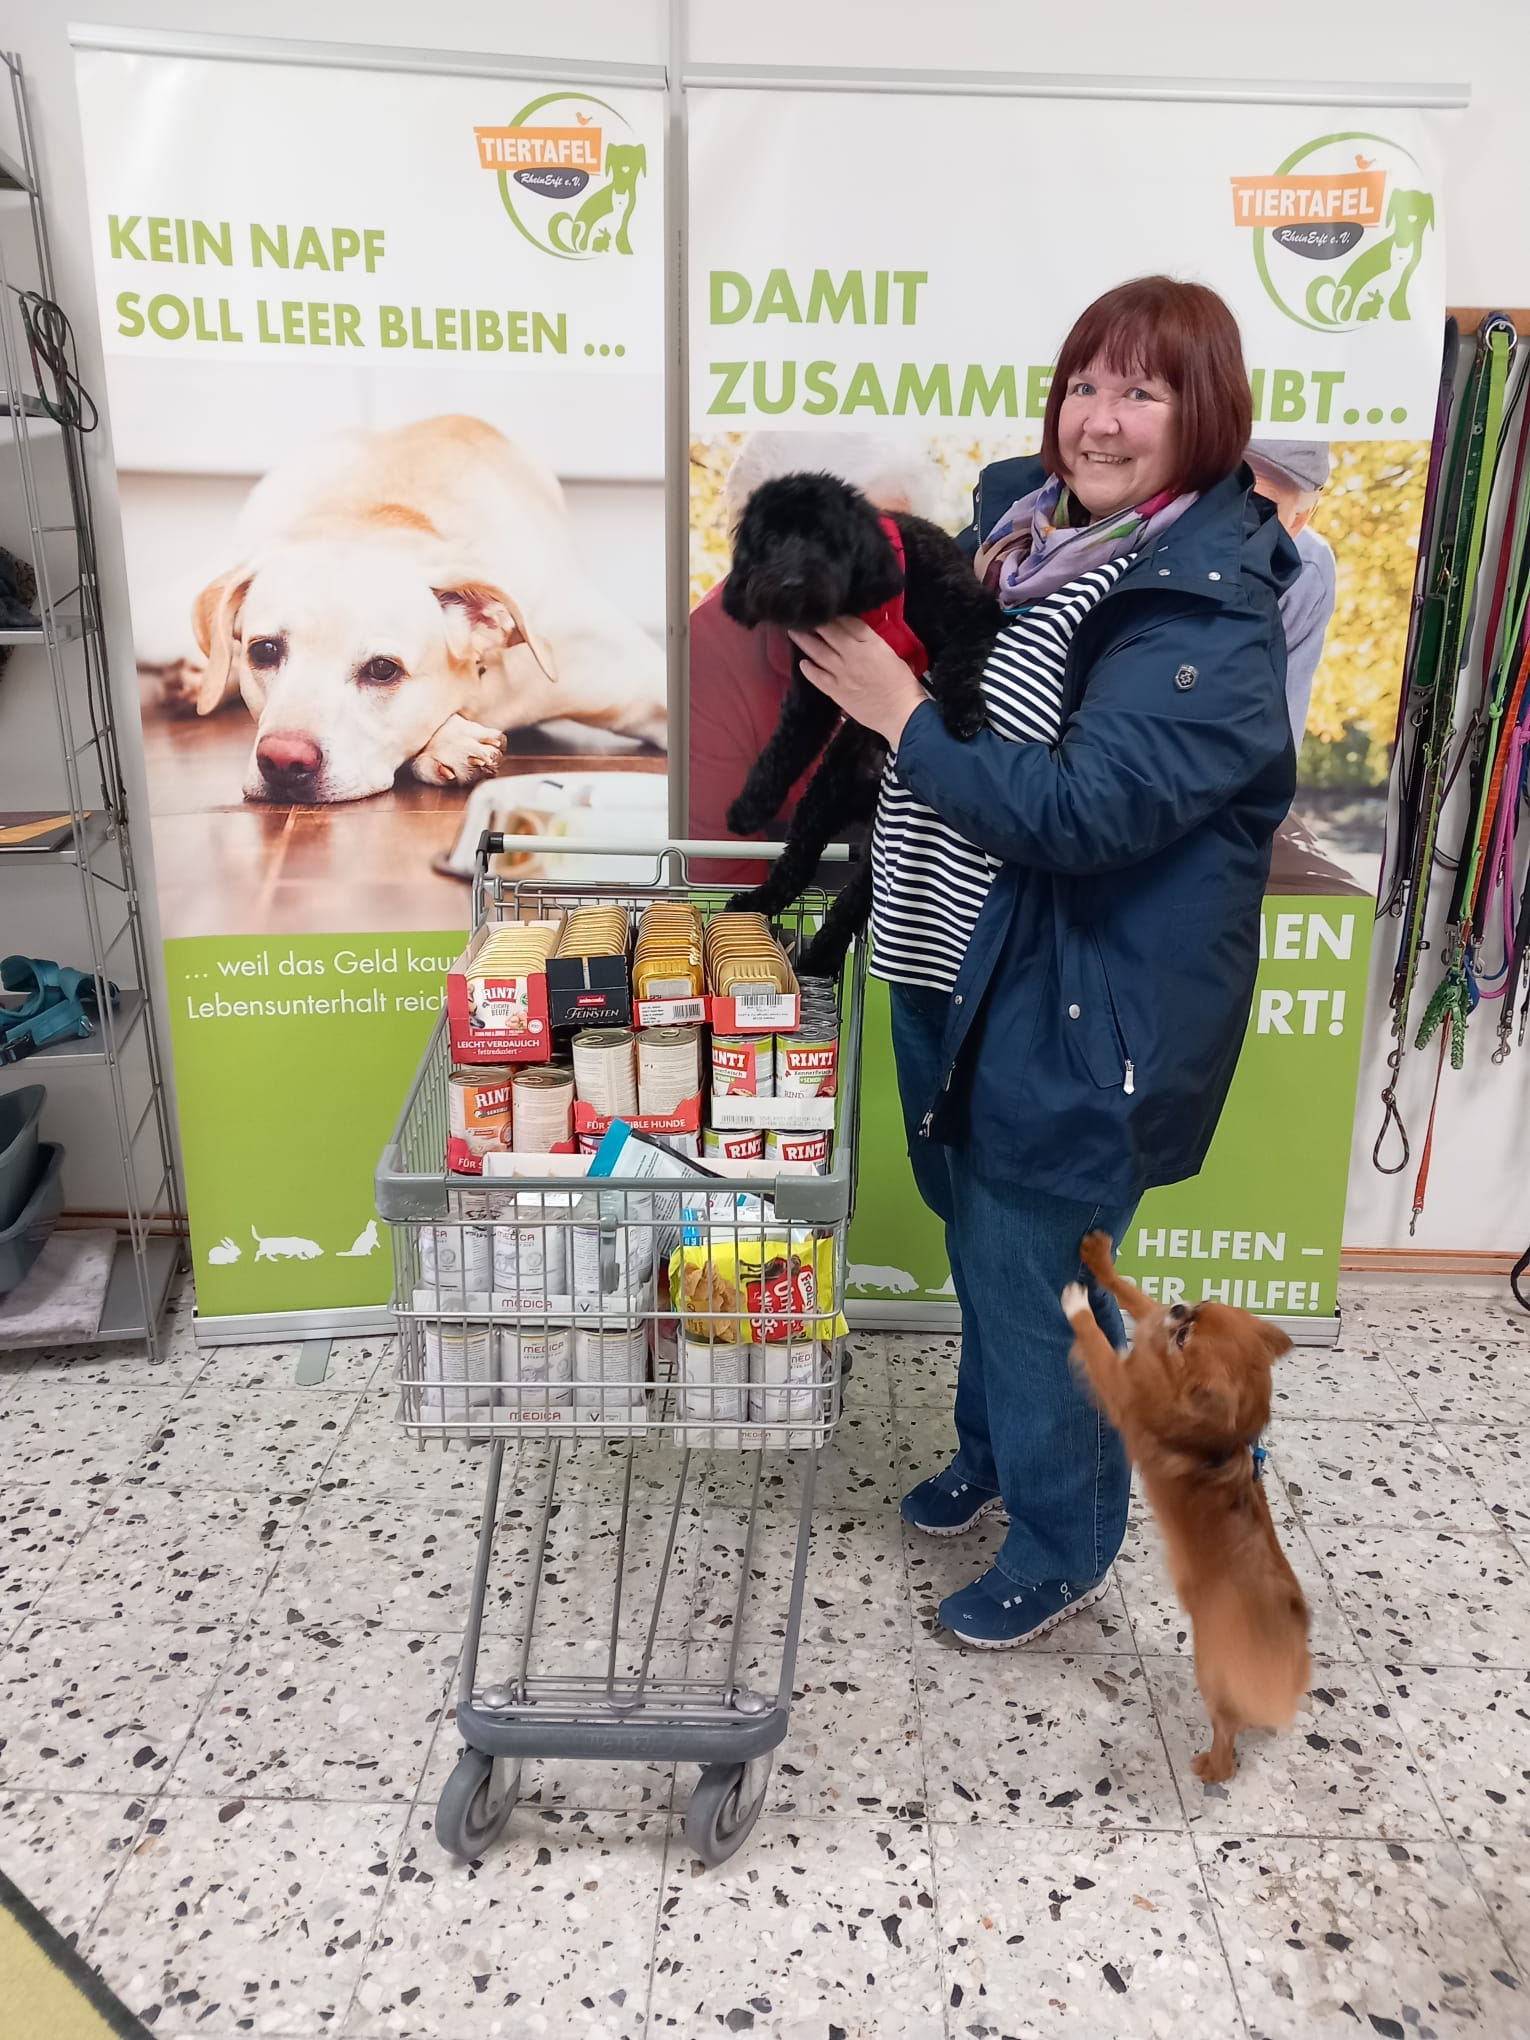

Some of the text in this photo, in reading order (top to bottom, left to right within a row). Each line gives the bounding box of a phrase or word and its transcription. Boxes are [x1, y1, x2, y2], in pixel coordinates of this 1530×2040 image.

[481, 137, 597, 164] TIERTAFEL
[520, 172, 563, 187] RheinErft
[1238, 187, 1375, 217] TIERTAFEL
[108, 214, 385, 274] KEIN NAPF
[1280, 229, 1328, 246] RheinErft
[709, 268, 928, 325] DAMIT
[115, 291, 244, 343] SOLL
[257, 297, 366, 348] LEER
[379, 305, 567, 356] BLEIBEN
[706, 360, 1408, 425] ZUSAMME IBT...
[1260, 913, 1355, 960] EN
[217, 950, 269, 977] weil
[279, 950, 325, 976] das
[334, 948, 397, 974] Geld
[407, 948, 458, 972] kau
[187, 986, 448, 1019] Lebensunterhalt reich
[1250, 989, 1346, 1036] RT!
[457, 1039, 540, 1049] LEICHT VERDAULICH
[788, 1051, 834, 1068] RINTI
[475, 1086, 511, 1107] RINT
[587, 1120, 604, 1130] FÜR
[651, 1119, 686, 1129] HUNDE
[458, 1158, 476, 1168] FÜR
[728, 1140, 762, 1159] RINT
[1138, 1228, 1286, 1261] HELFEN
[1202, 1278, 1320, 1311] HILFE!
